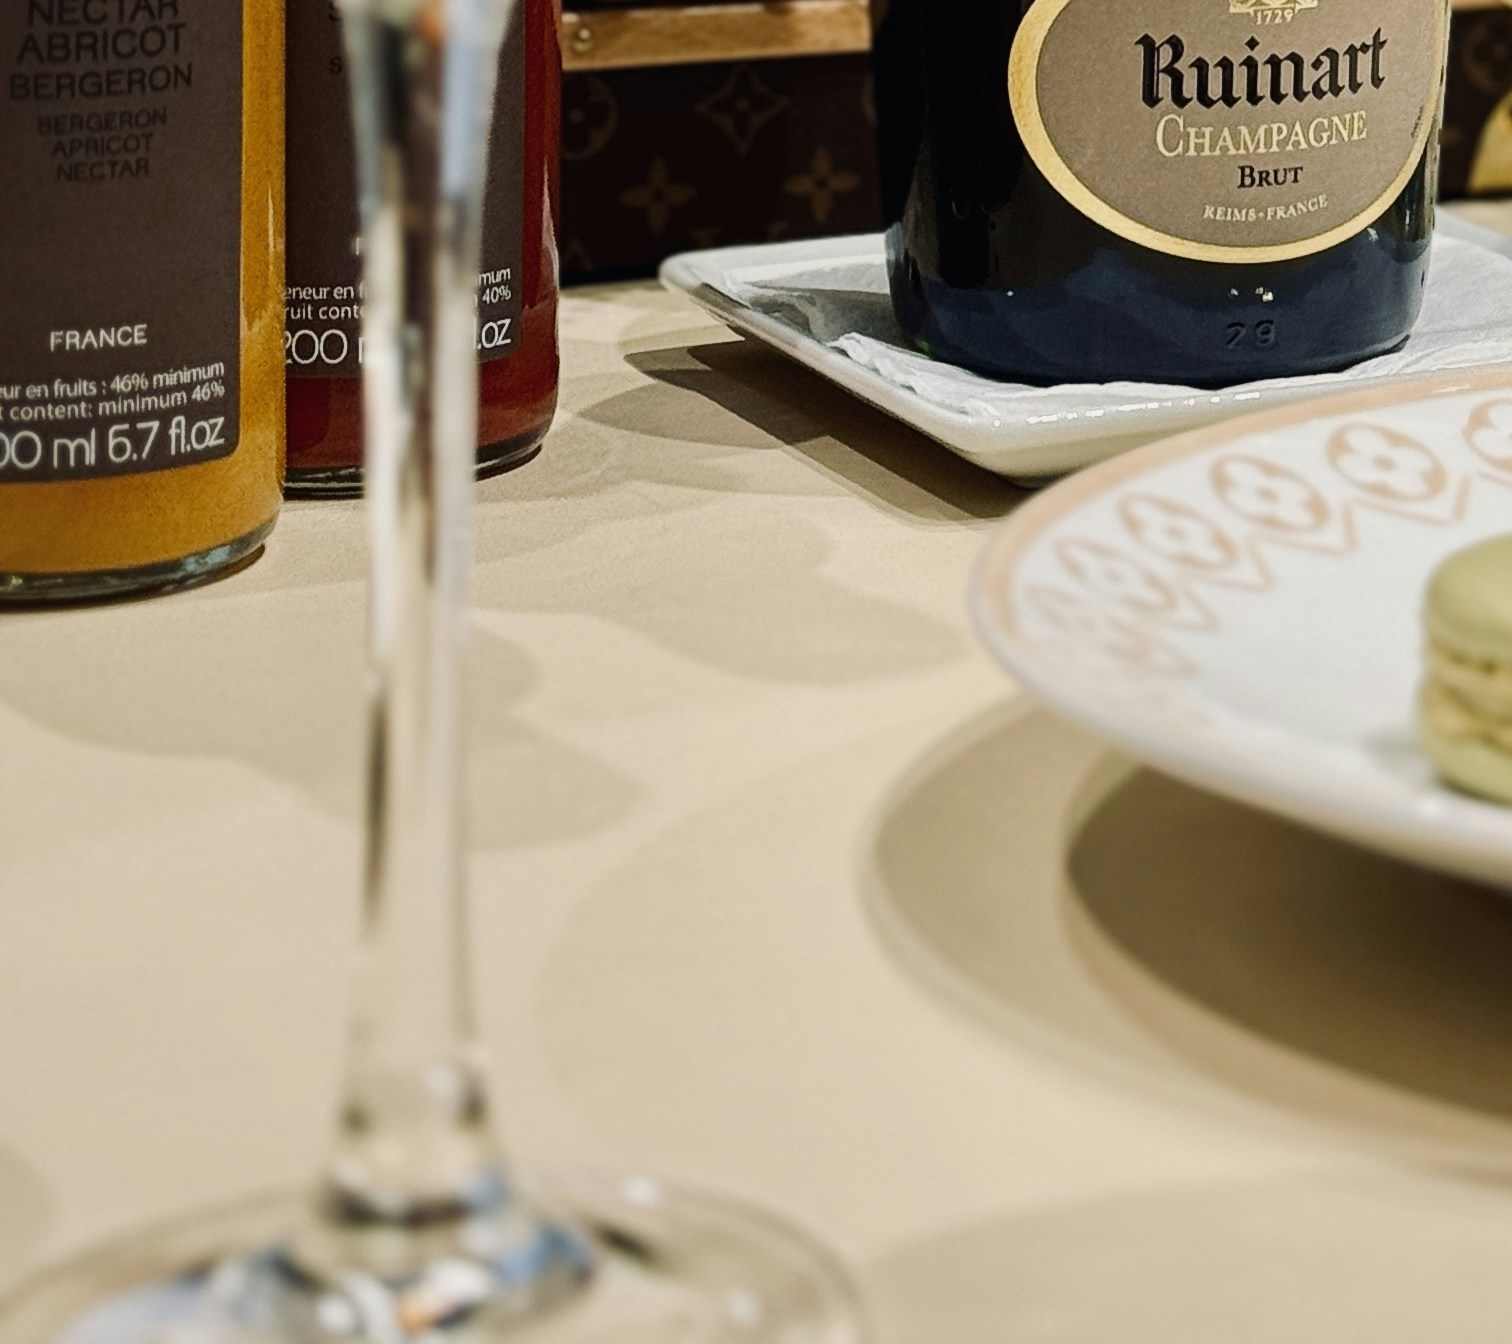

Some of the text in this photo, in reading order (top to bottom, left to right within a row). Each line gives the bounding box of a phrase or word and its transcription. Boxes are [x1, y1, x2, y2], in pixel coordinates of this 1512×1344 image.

[17, 23, 187, 63] ABRICOT
[9, 63, 193, 101] BERGERON
[1134, 26, 1388, 109] Ruinart
[38, 107, 168, 135] BERGERON
[52, 132, 154, 159] APRICOT
[56, 158, 150, 182] NECTAR
[333, 286, 355, 300] en
[482, 285, 512, 305] 40%
[50, 324, 148, 352] FRANCE
[25, 384, 49, 399] en
[53, 378, 97, 399] fruits
[110, 373, 149, 393] 46%
[152, 362, 225, 389] minimum
[98, 391, 187, 417] minimum
[191, 379, 225, 402] 46%
[53, 427, 96, 469] ml
[108, 420, 160, 463] 6.7
